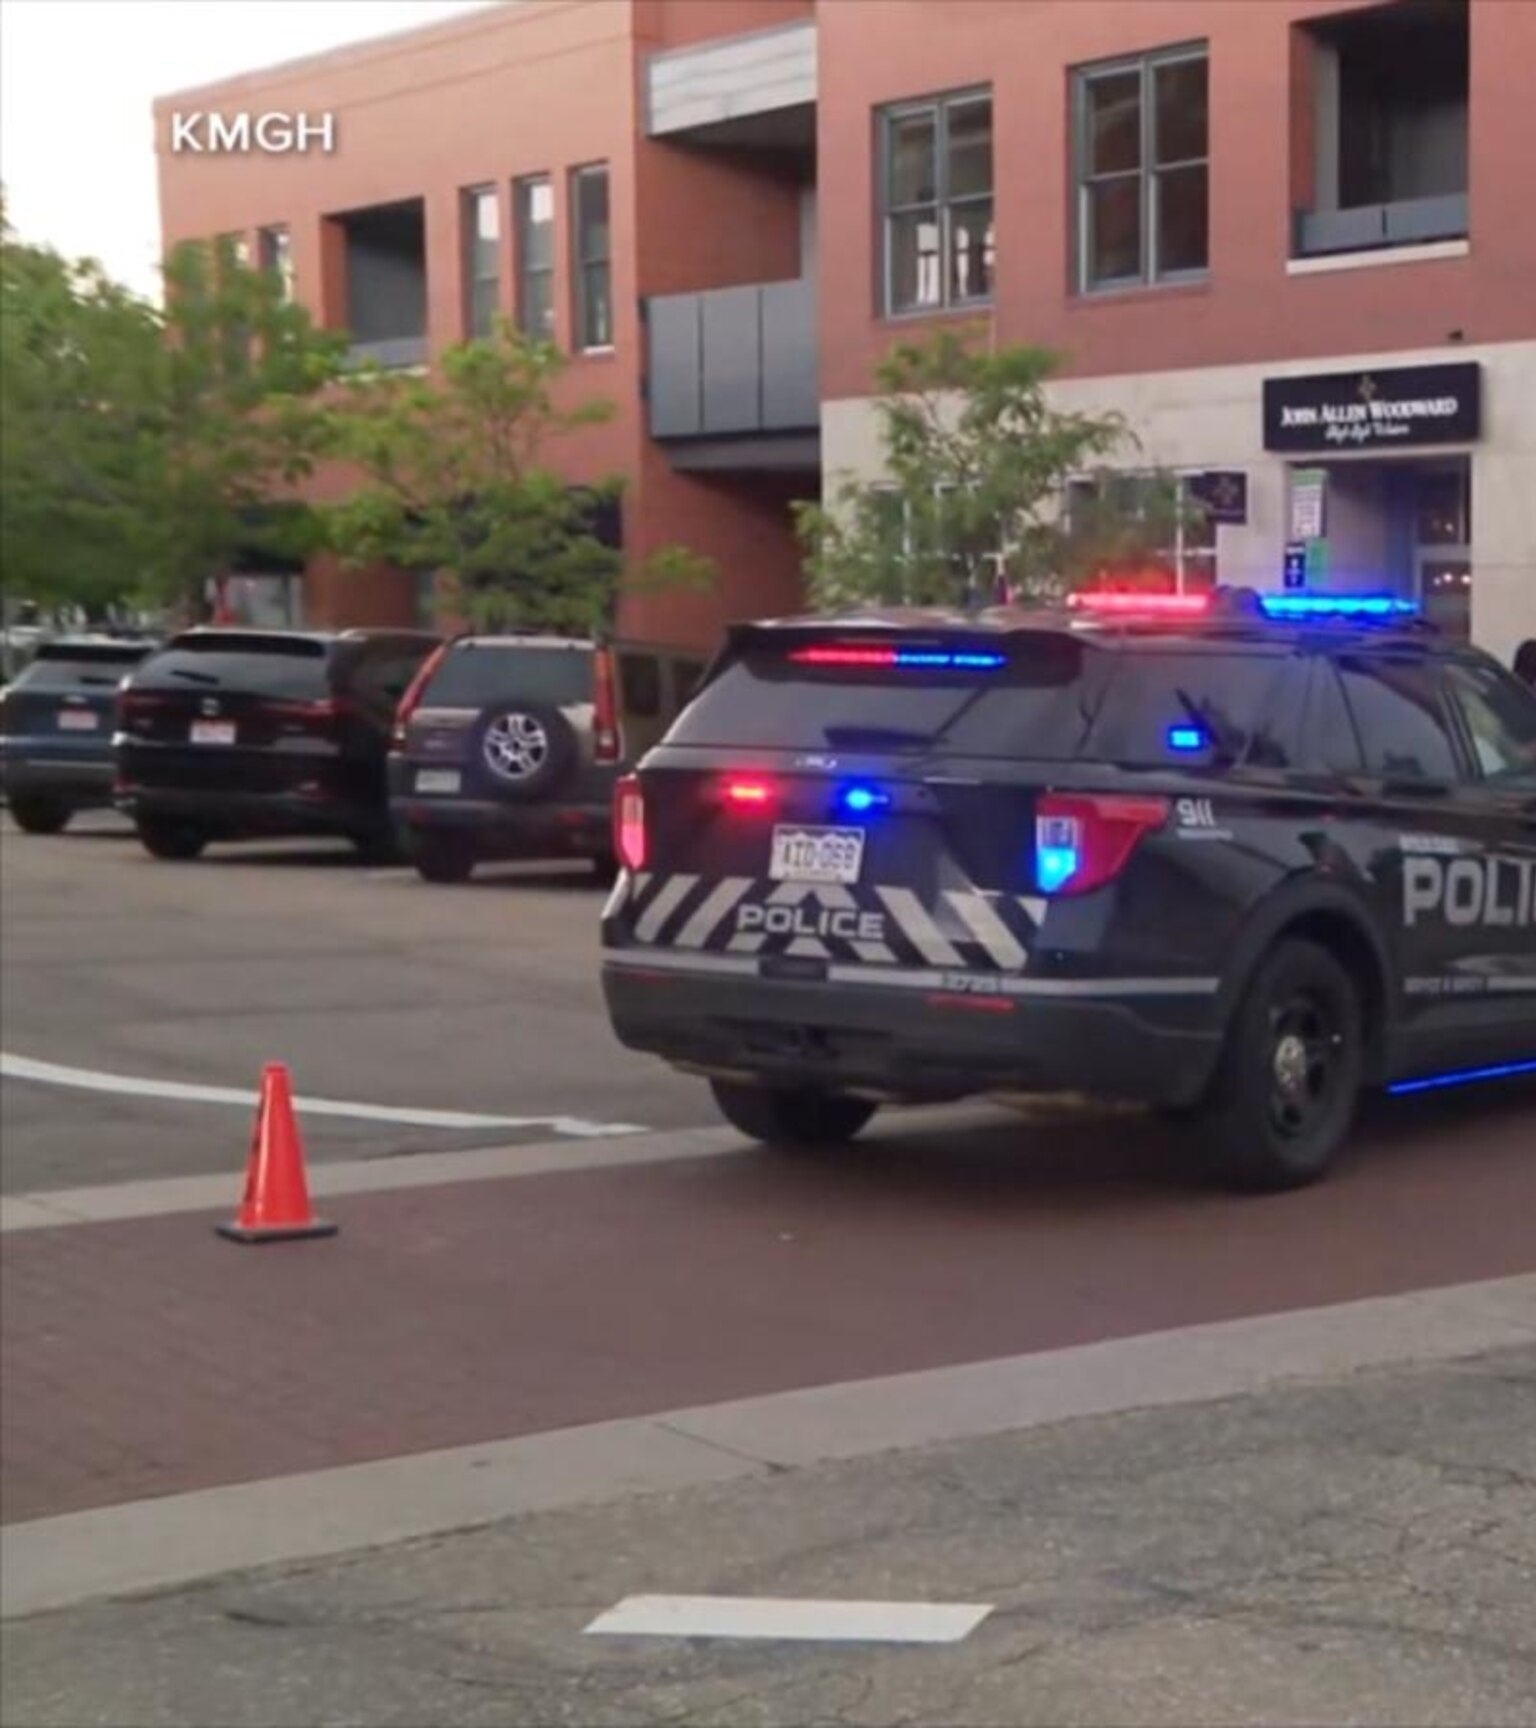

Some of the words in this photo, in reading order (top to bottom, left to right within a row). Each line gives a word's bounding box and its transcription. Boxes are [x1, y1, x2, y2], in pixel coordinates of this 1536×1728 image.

[1321, 403, 1367, 424] ALLEN
[1176, 798, 1216, 827] 911
[737, 903, 885, 939] POLICE
